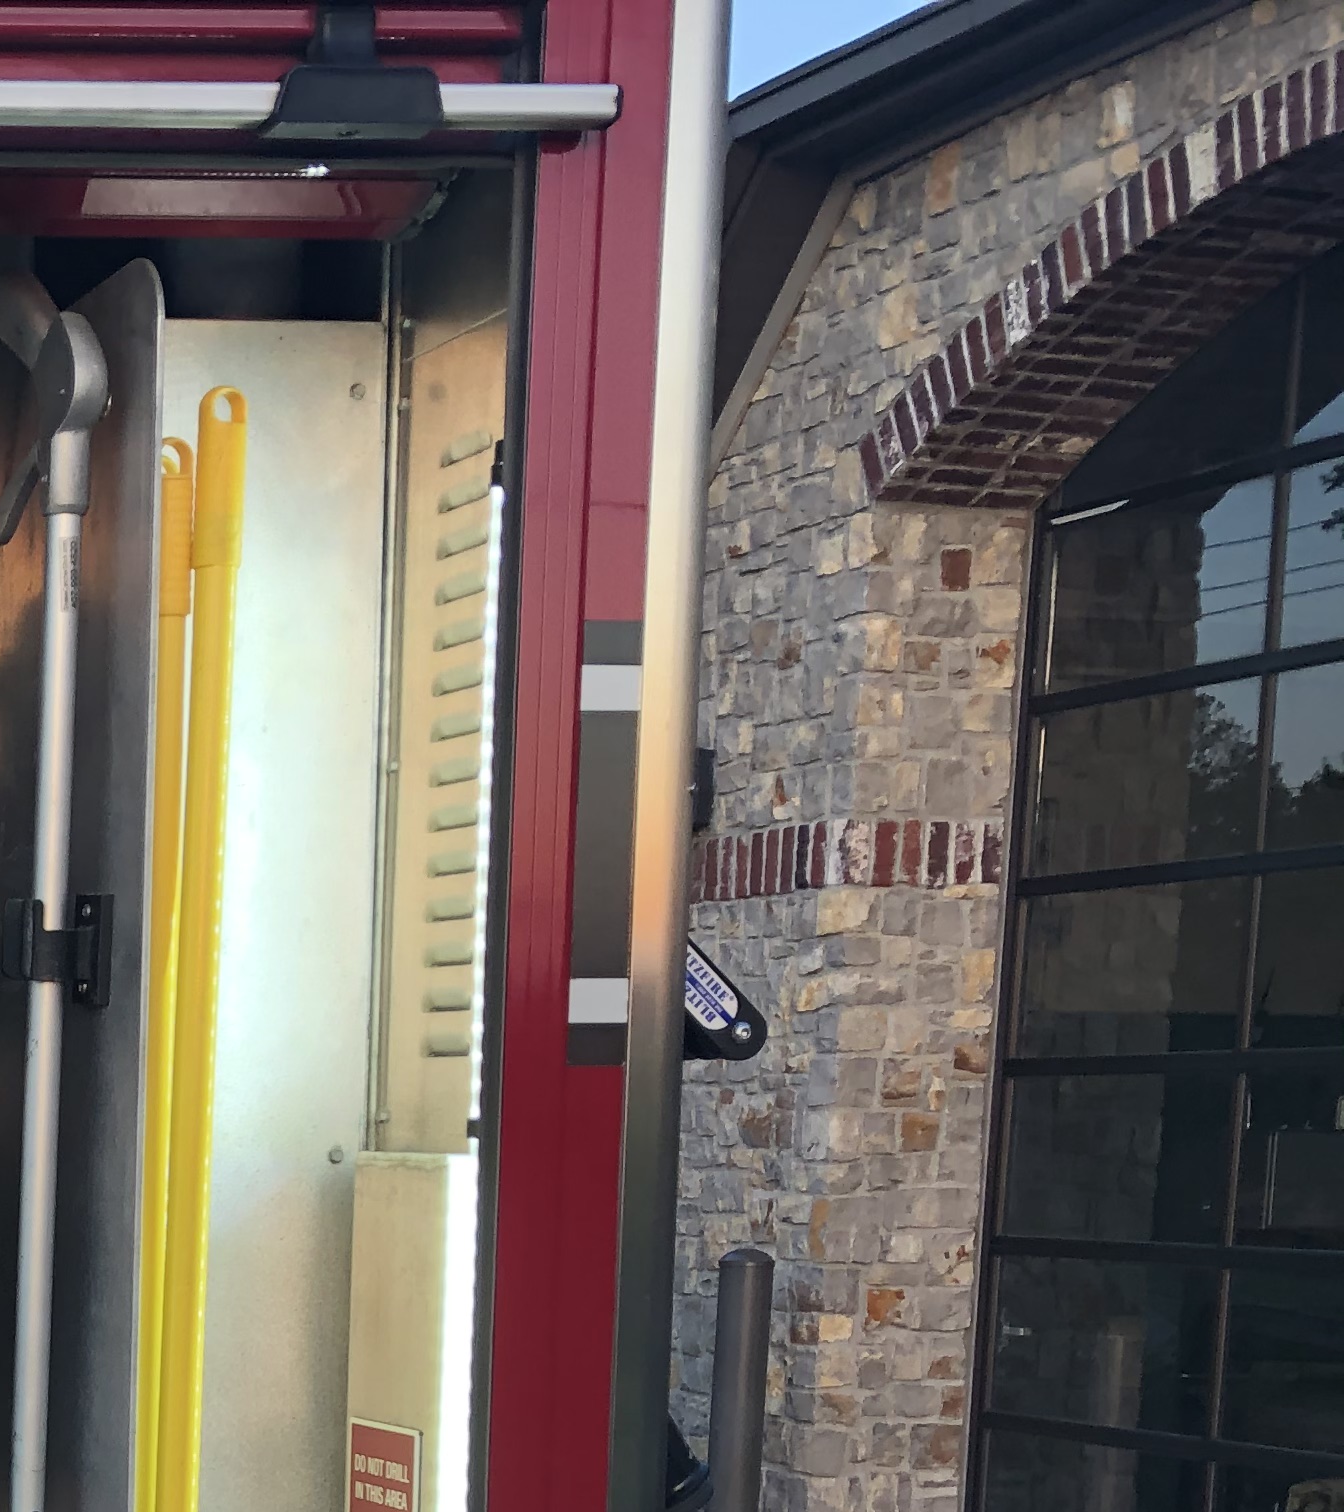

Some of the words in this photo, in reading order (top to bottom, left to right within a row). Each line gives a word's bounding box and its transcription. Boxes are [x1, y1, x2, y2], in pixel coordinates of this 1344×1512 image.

[354, 1453, 366, 1473] DO
[367, 1456, 385, 1477] NOT
[385, 1460, 410, 1483] DRILL
[354, 1480, 364, 1500] IN
[365, 1482, 384, 1505] THIS
[385, 1488, 408, 1511] AREA
